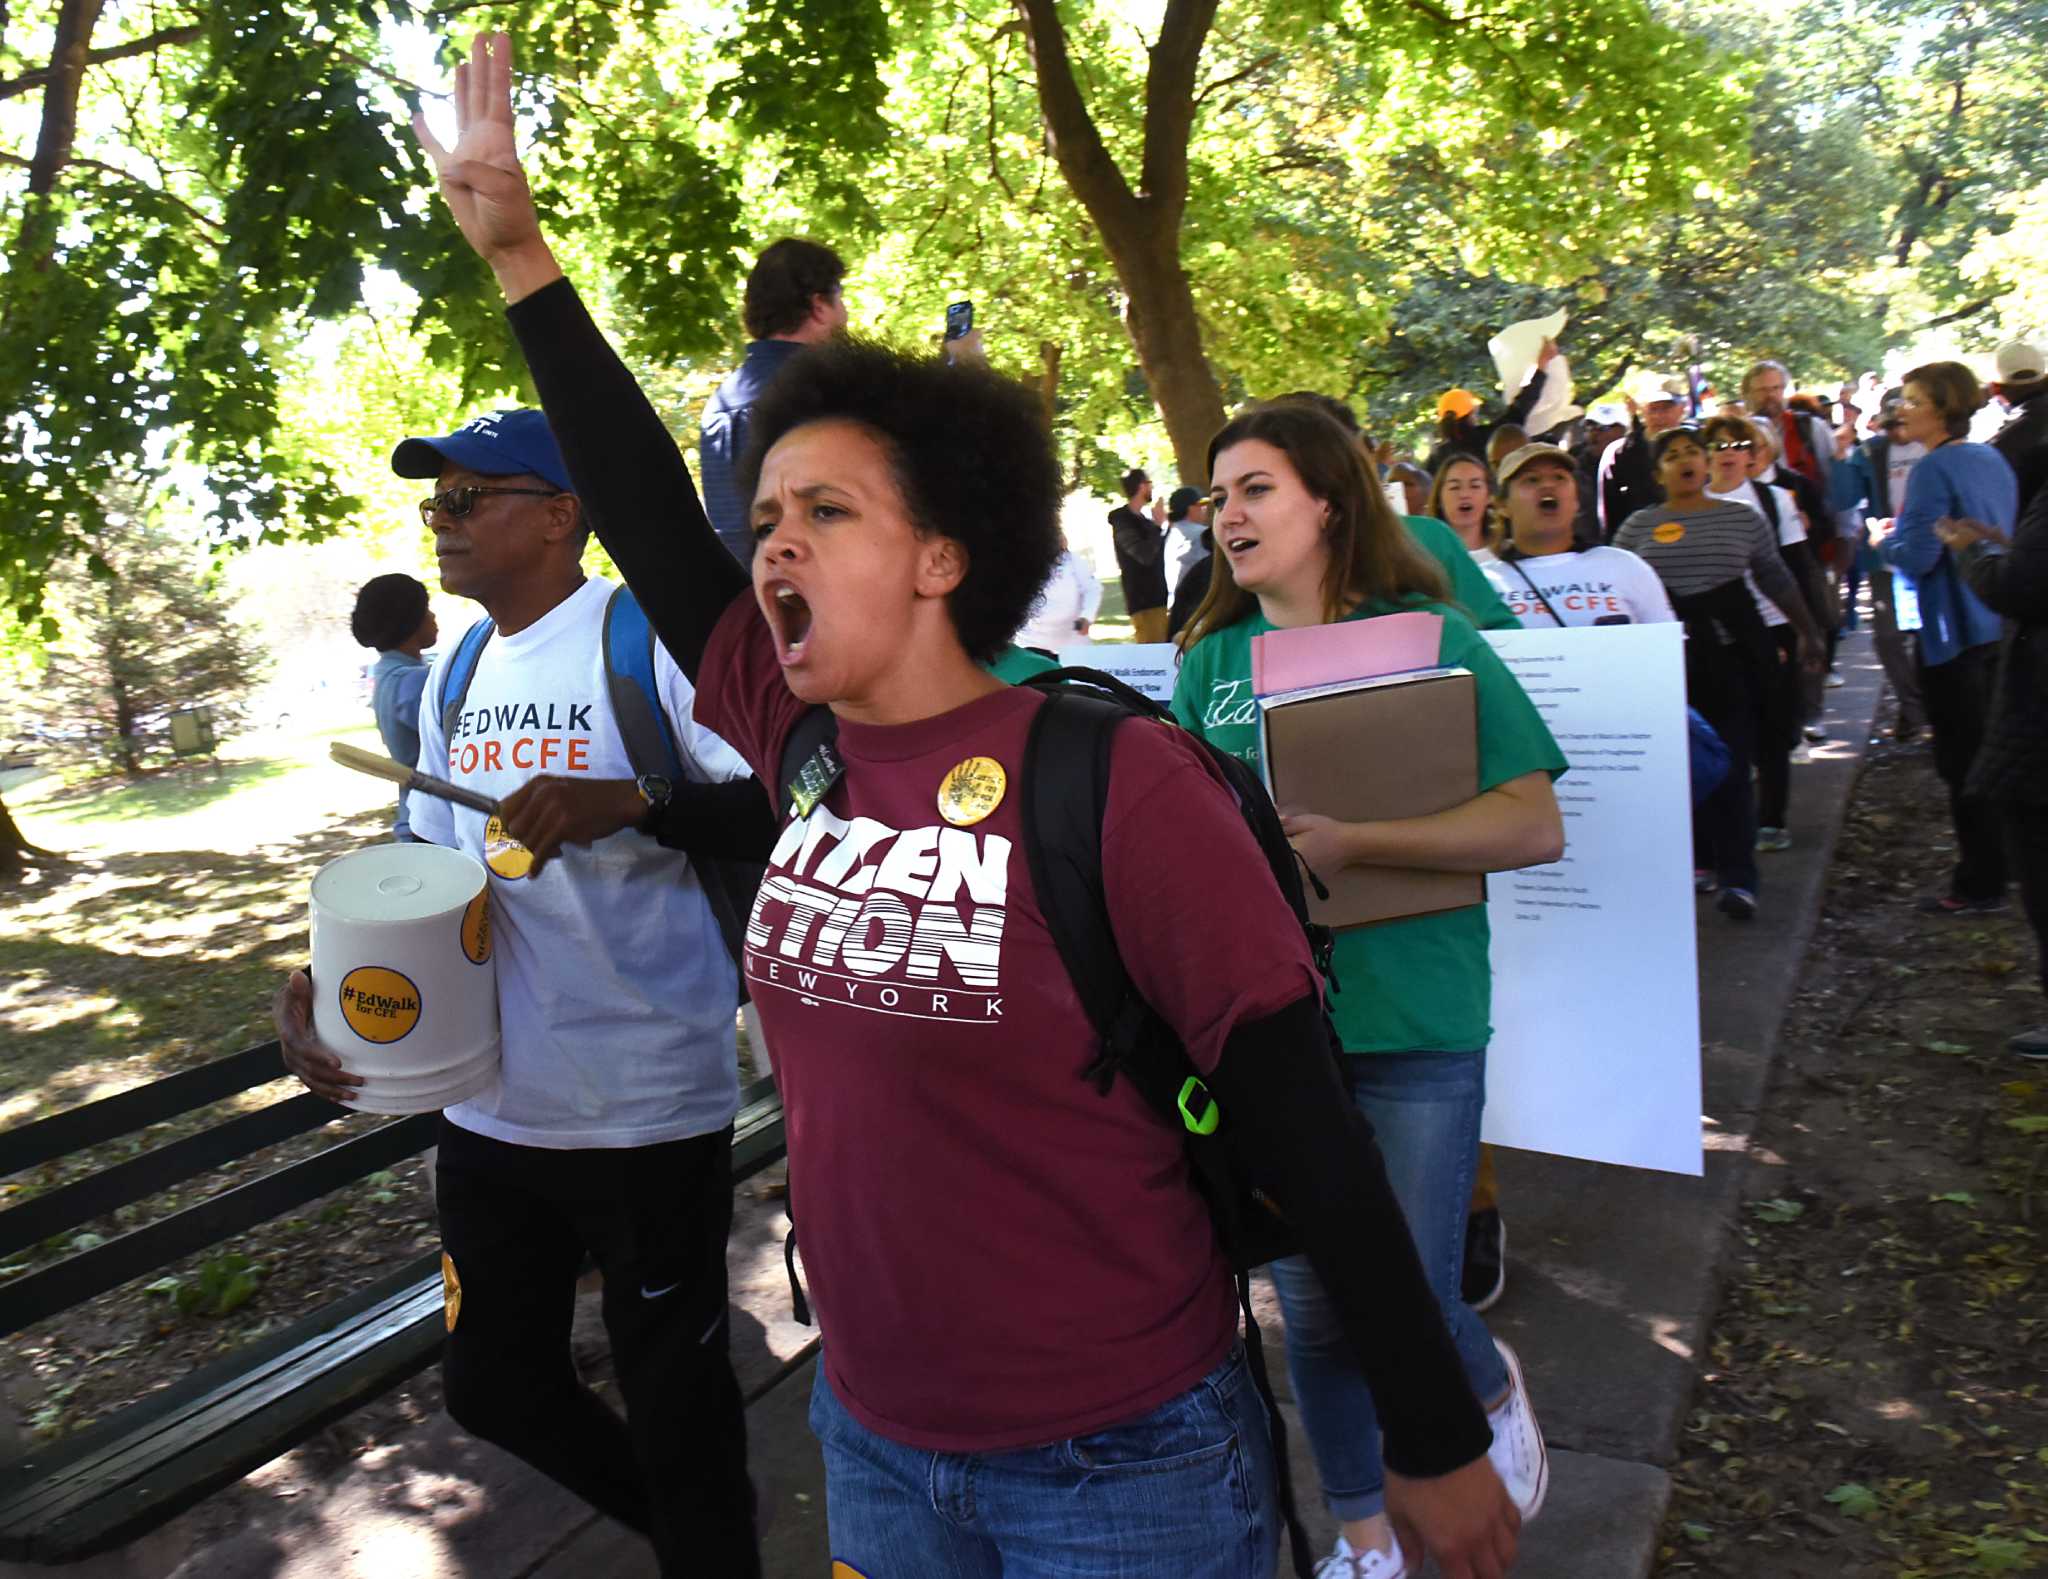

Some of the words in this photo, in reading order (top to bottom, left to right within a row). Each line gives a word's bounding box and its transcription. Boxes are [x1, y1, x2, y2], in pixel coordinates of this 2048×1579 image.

[1563, 595, 1620, 612] CFE
[512, 737, 590, 771] CFE
[343, 985, 417, 1010] #EdWalk
[356, 1002, 373, 1014] for
[374, 1007, 398, 1018] CFE
[846, 982, 1003, 1016] YORK
